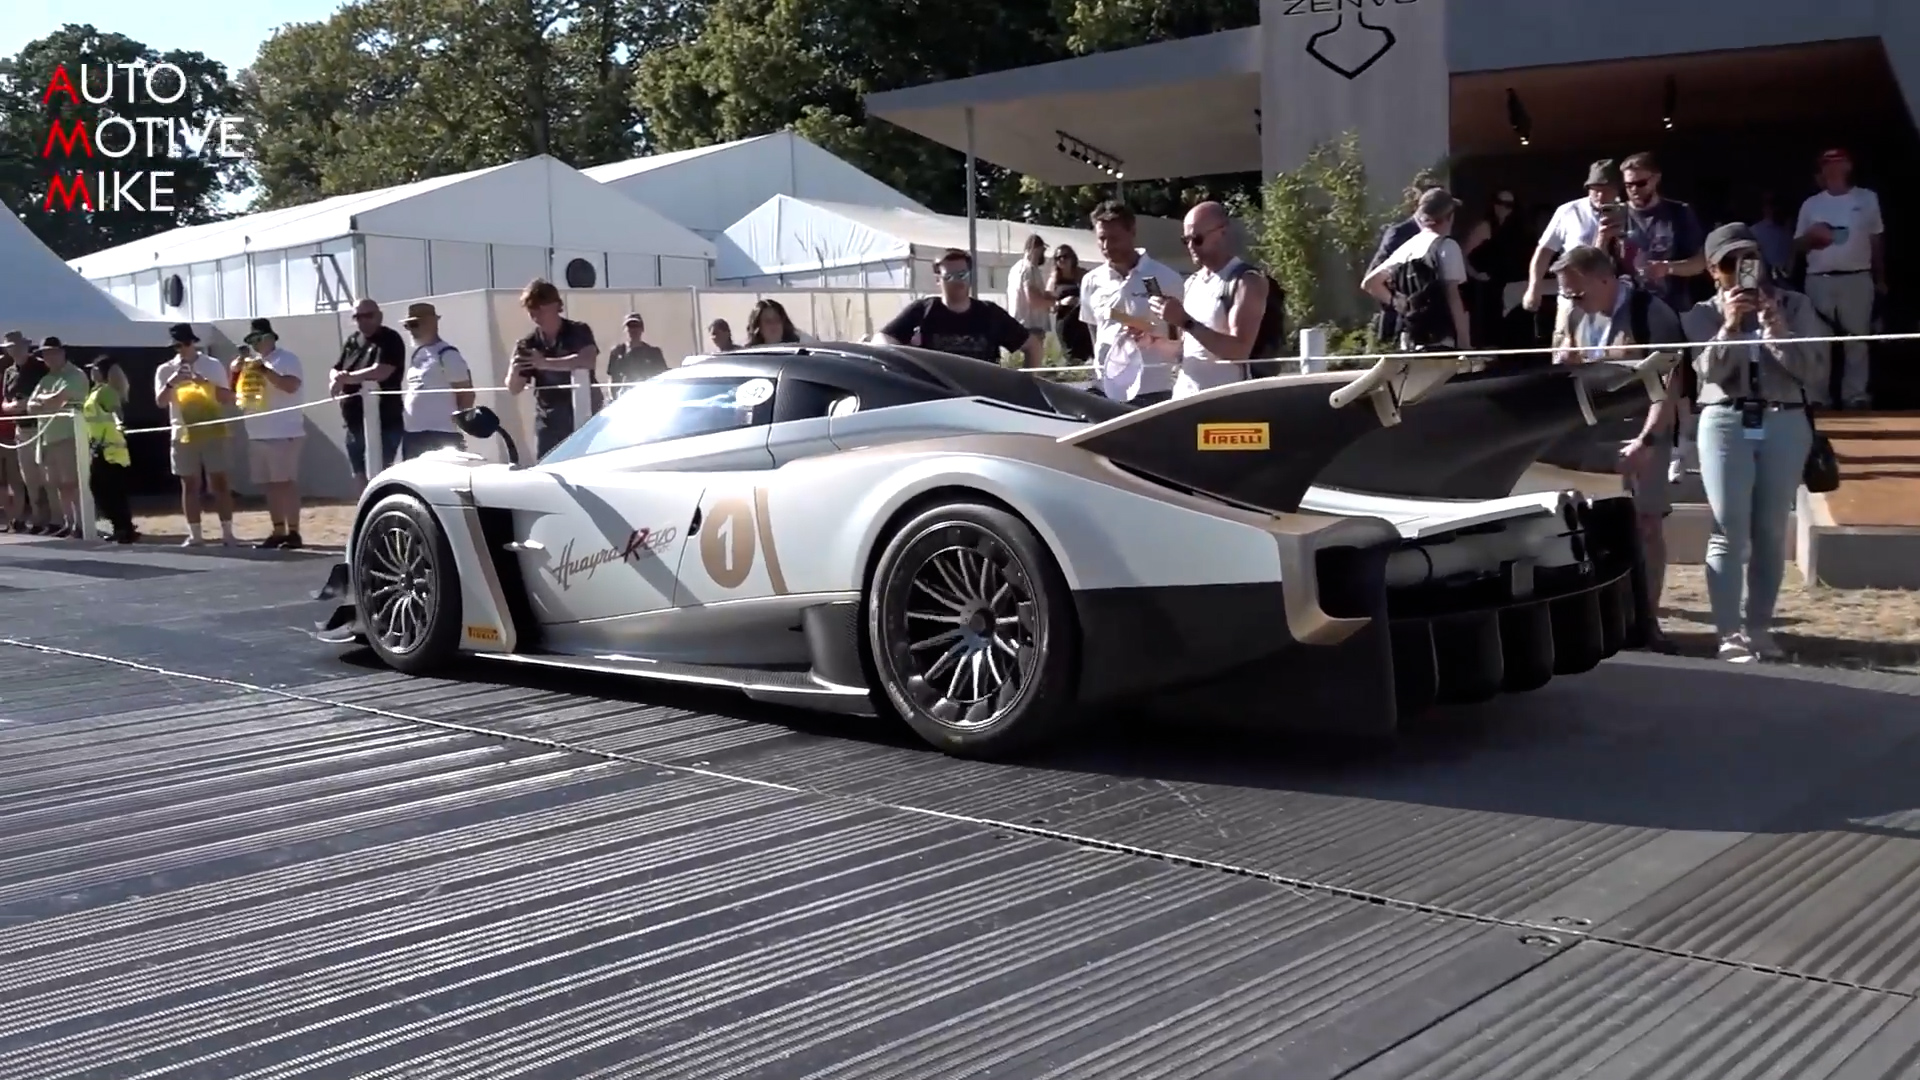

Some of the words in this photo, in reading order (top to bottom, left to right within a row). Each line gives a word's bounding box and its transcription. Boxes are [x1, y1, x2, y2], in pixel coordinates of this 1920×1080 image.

[1203, 428, 1263, 444] PIRELLI
[552, 537, 622, 591] Huayra
[717, 514, 733, 571] 1
